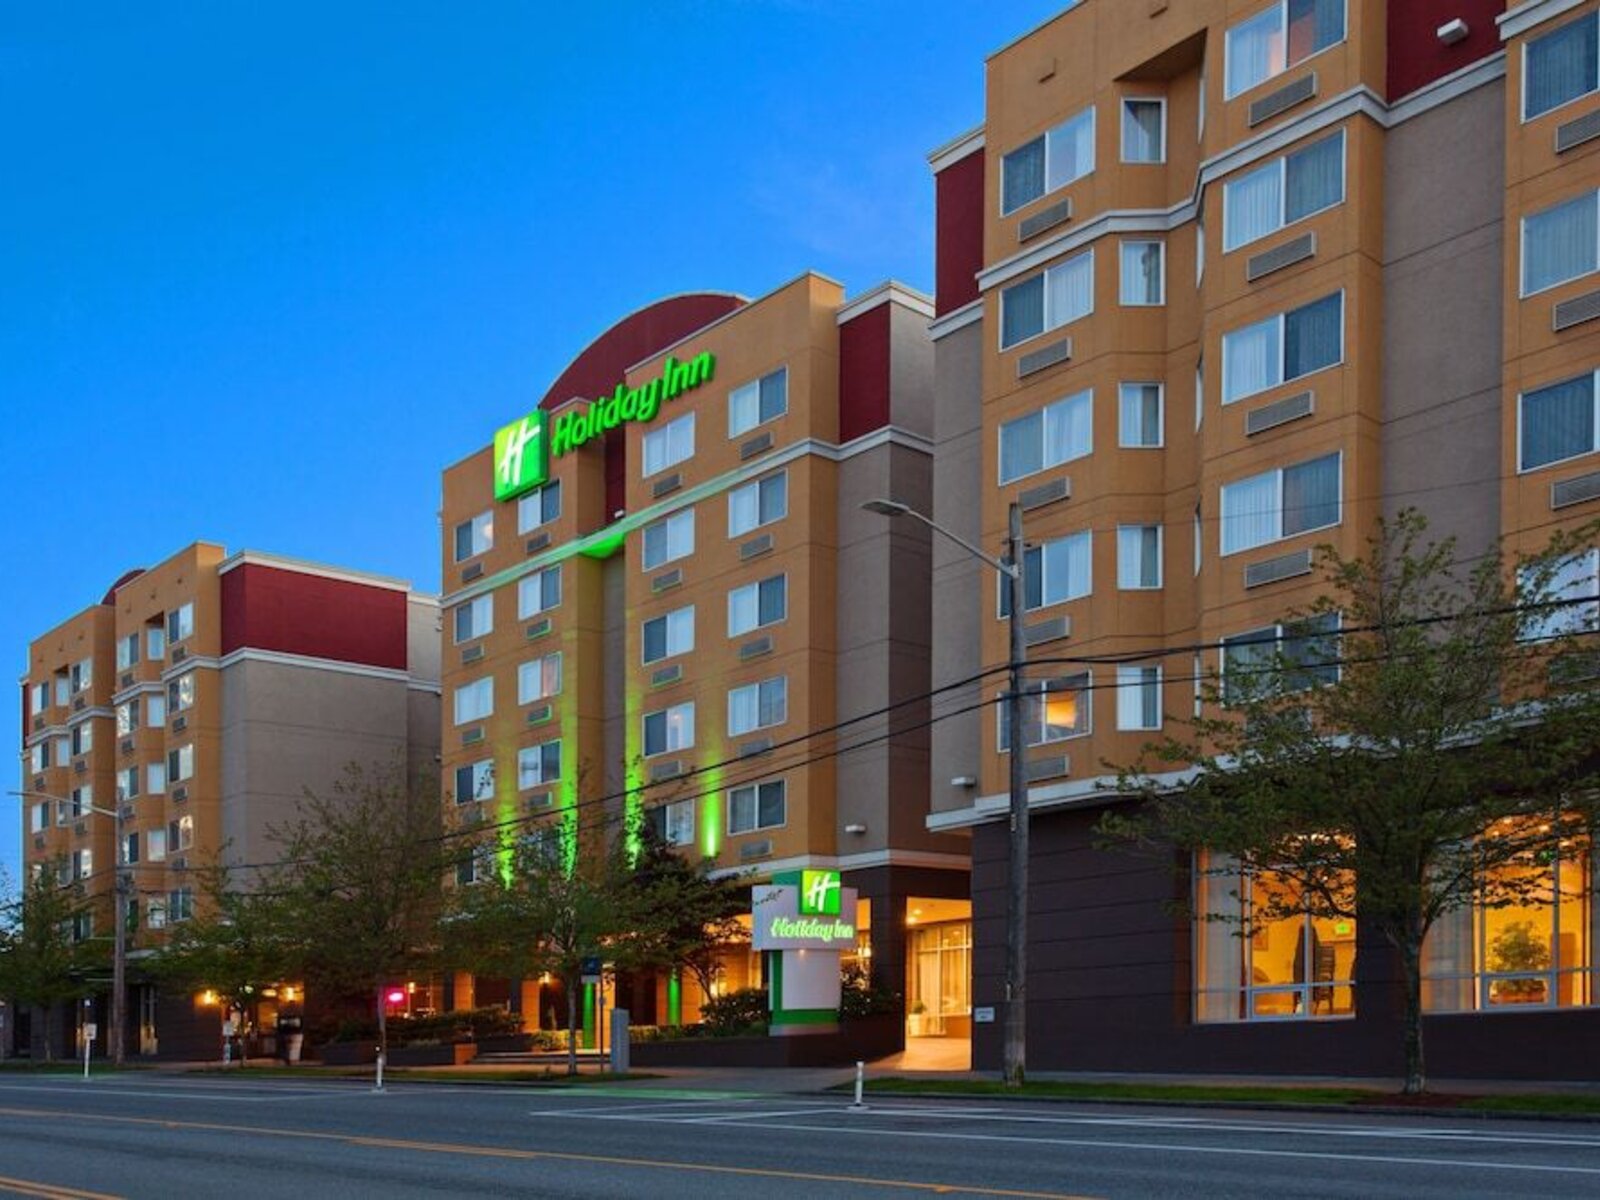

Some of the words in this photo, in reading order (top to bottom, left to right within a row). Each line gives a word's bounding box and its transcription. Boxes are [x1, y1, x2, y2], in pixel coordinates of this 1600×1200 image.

[551, 379, 661, 456] Holiday
[661, 350, 716, 400] Inn
[771, 917, 833, 942] Holiday
[834, 919, 853, 939] Inn
